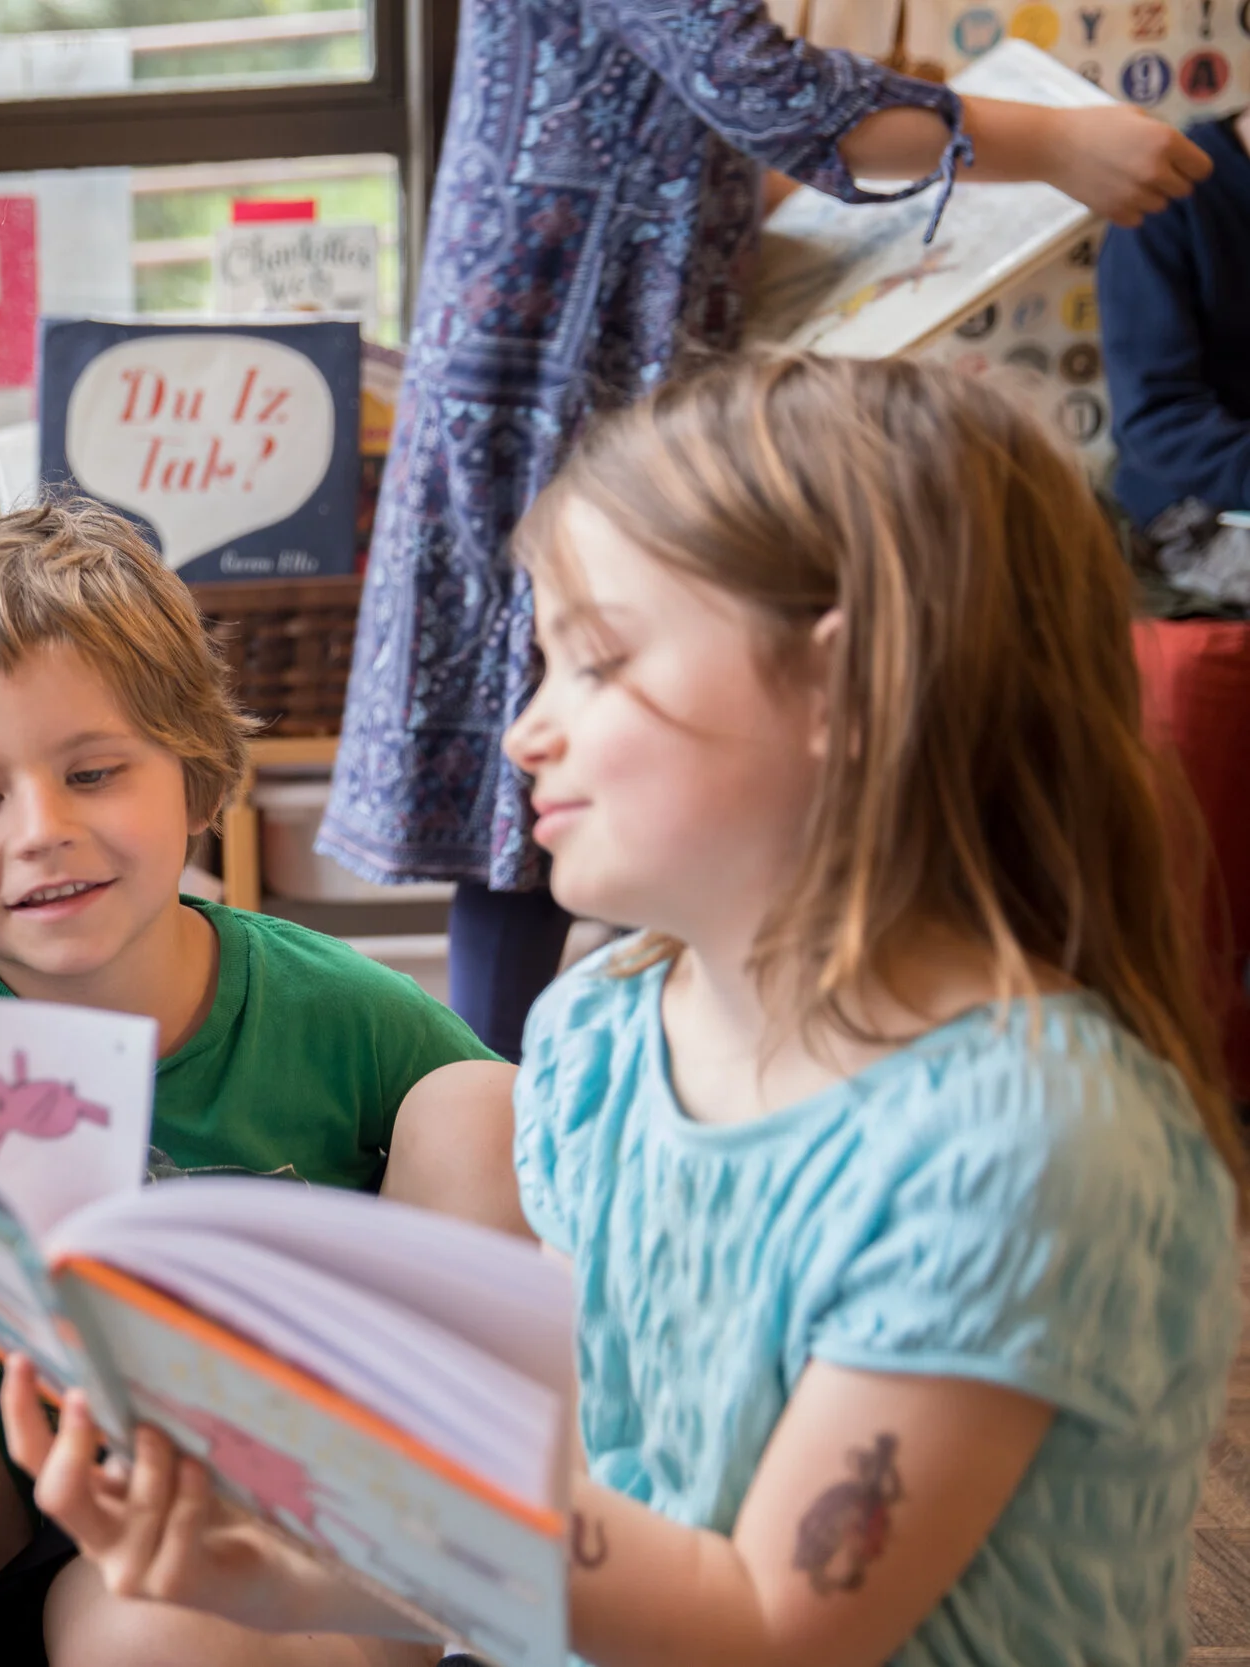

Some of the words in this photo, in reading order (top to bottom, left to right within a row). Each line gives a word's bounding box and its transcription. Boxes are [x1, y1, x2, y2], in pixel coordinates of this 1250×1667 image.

[1078, 8, 1103, 46] Y
[118, 364, 205, 426] Du
[231, 364, 295, 426] Iz
[134, 433, 278, 493] Tak?
